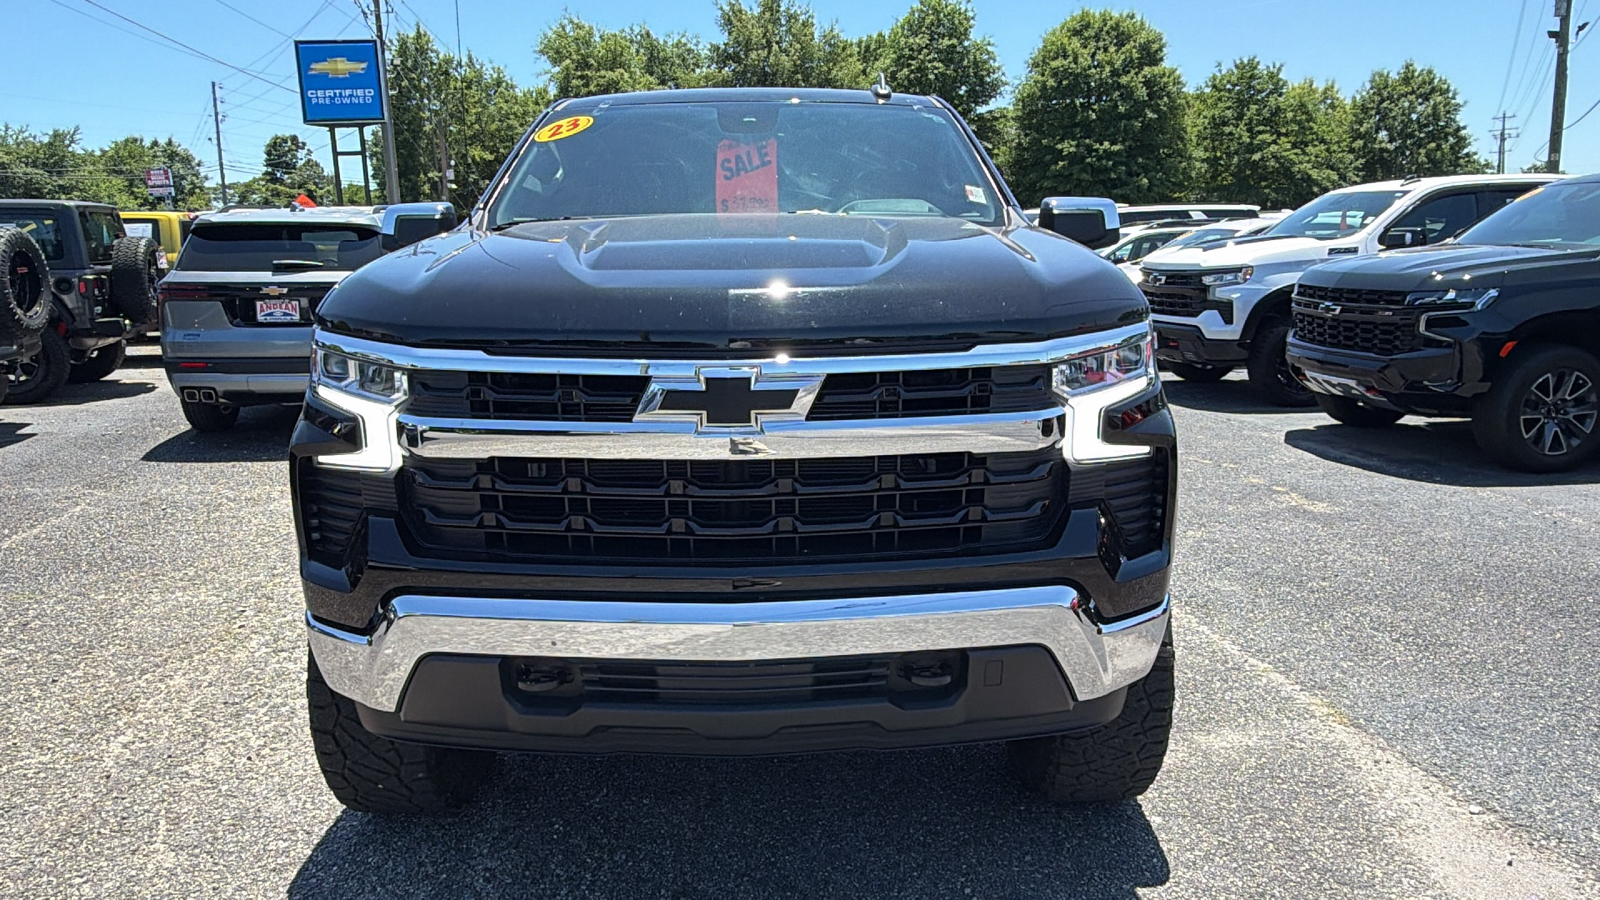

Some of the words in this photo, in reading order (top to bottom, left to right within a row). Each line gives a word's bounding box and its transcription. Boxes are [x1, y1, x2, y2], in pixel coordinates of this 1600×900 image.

[307, 89, 374, 98] CERTIFIED
[547, 118, 580, 138] 23
[720, 144, 773, 181] SALE
[259, 303, 298, 315] ANDEAN
